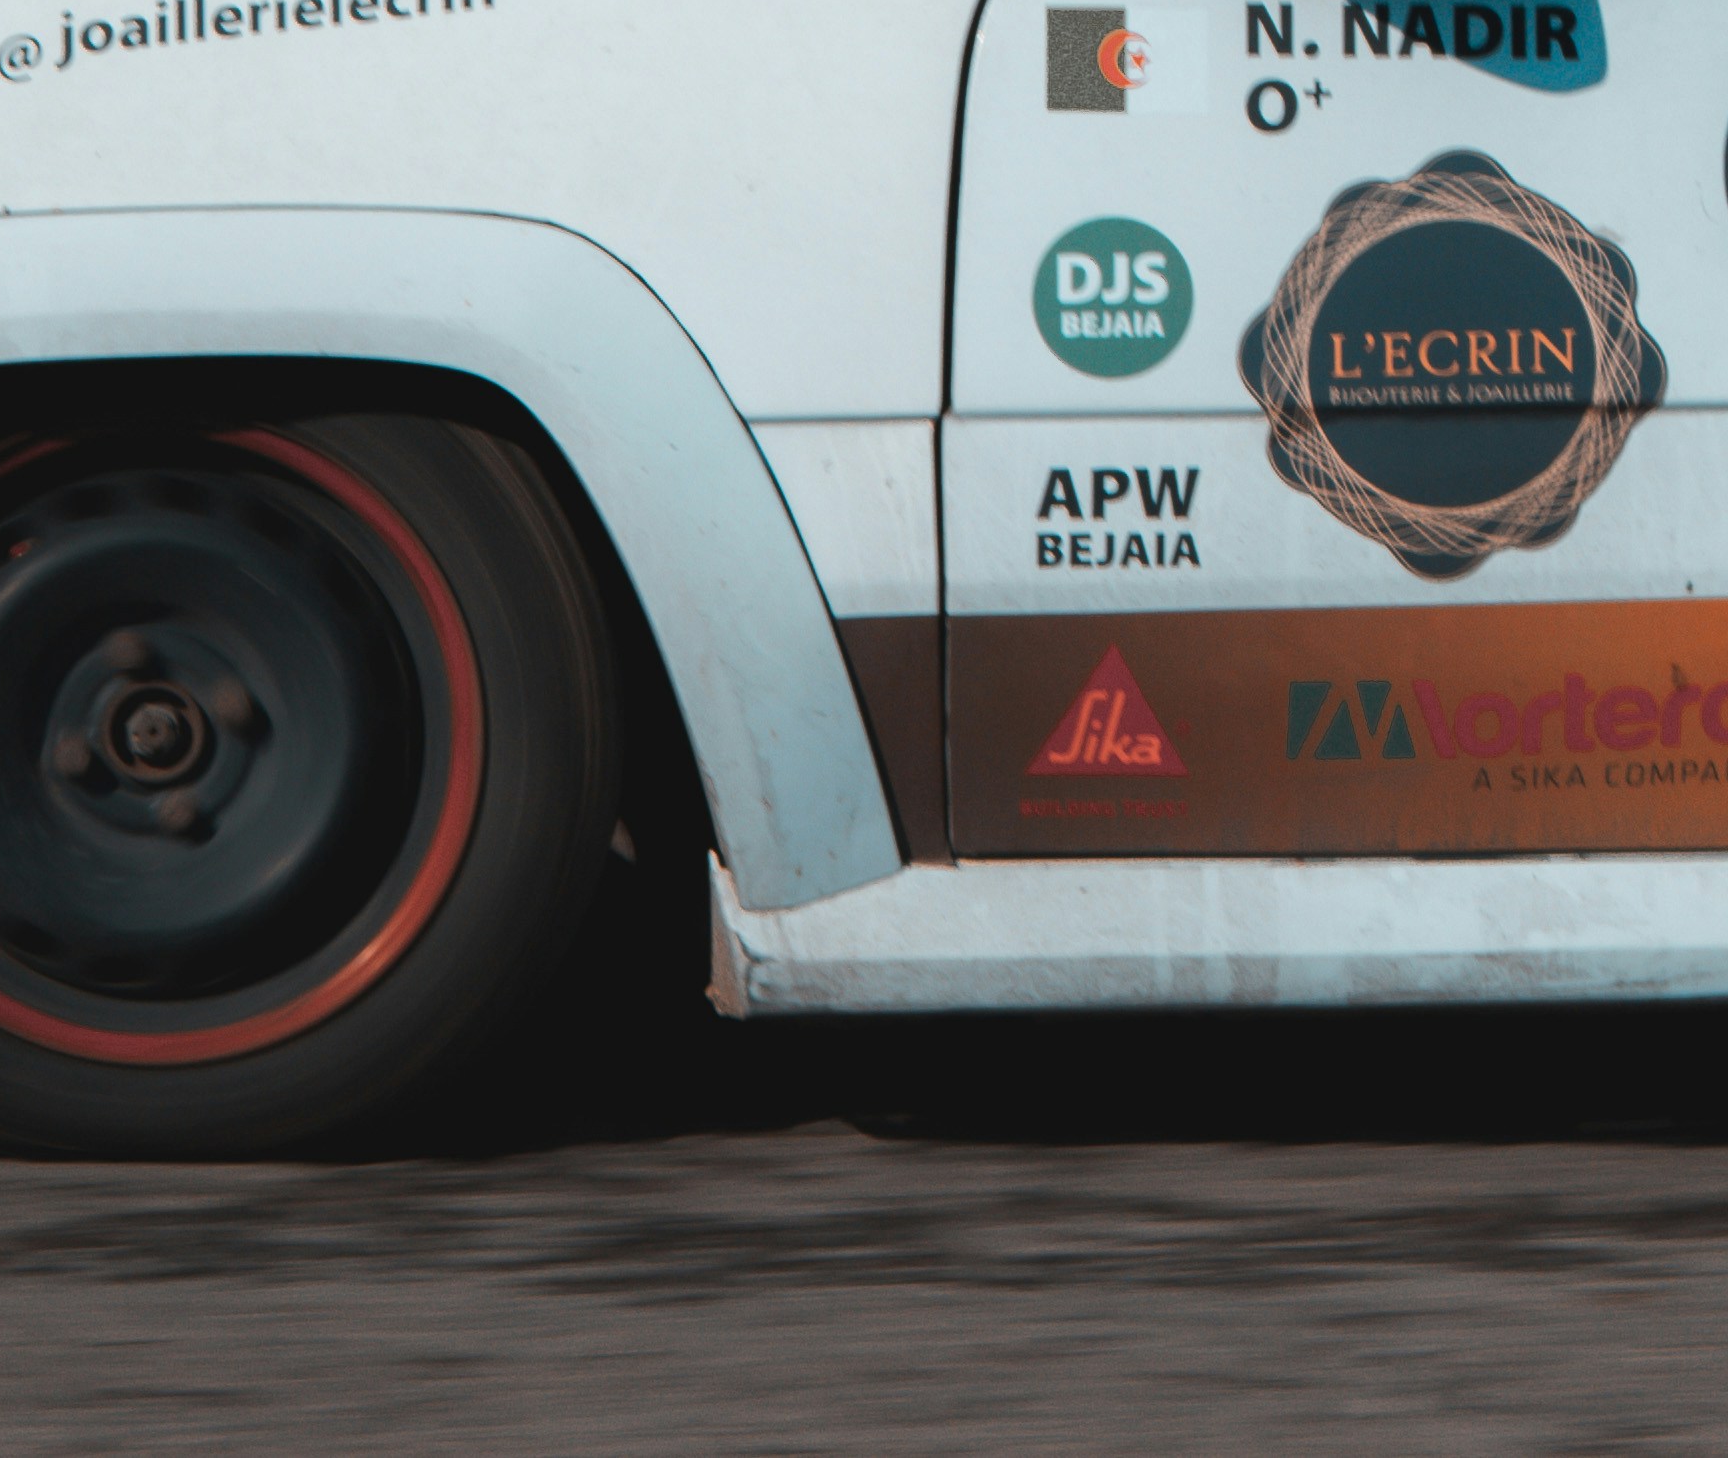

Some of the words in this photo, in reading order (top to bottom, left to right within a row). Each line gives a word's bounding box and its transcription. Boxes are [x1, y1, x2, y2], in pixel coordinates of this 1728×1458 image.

[1244, 2, 1319, 60] N.
[1341, 2, 1580, 62] NADIR
[1055, 251, 1168, 306] DJS
[1059, 311, 1165, 340] BEJAIA
[1328, 385, 1442, 407] BIJOUTERIE
[1445, 384, 1463, 404] &
[1466, 381, 1575, 404] JOAILLERIE
[1037, 468, 1201, 521] APW
[1036, 529, 1202, 570] BEJAIA
[1048, 688, 1162, 766] Sika
[1472, 766, 1492, 792] A
[1510, 763, 1587, 792] SIKA
